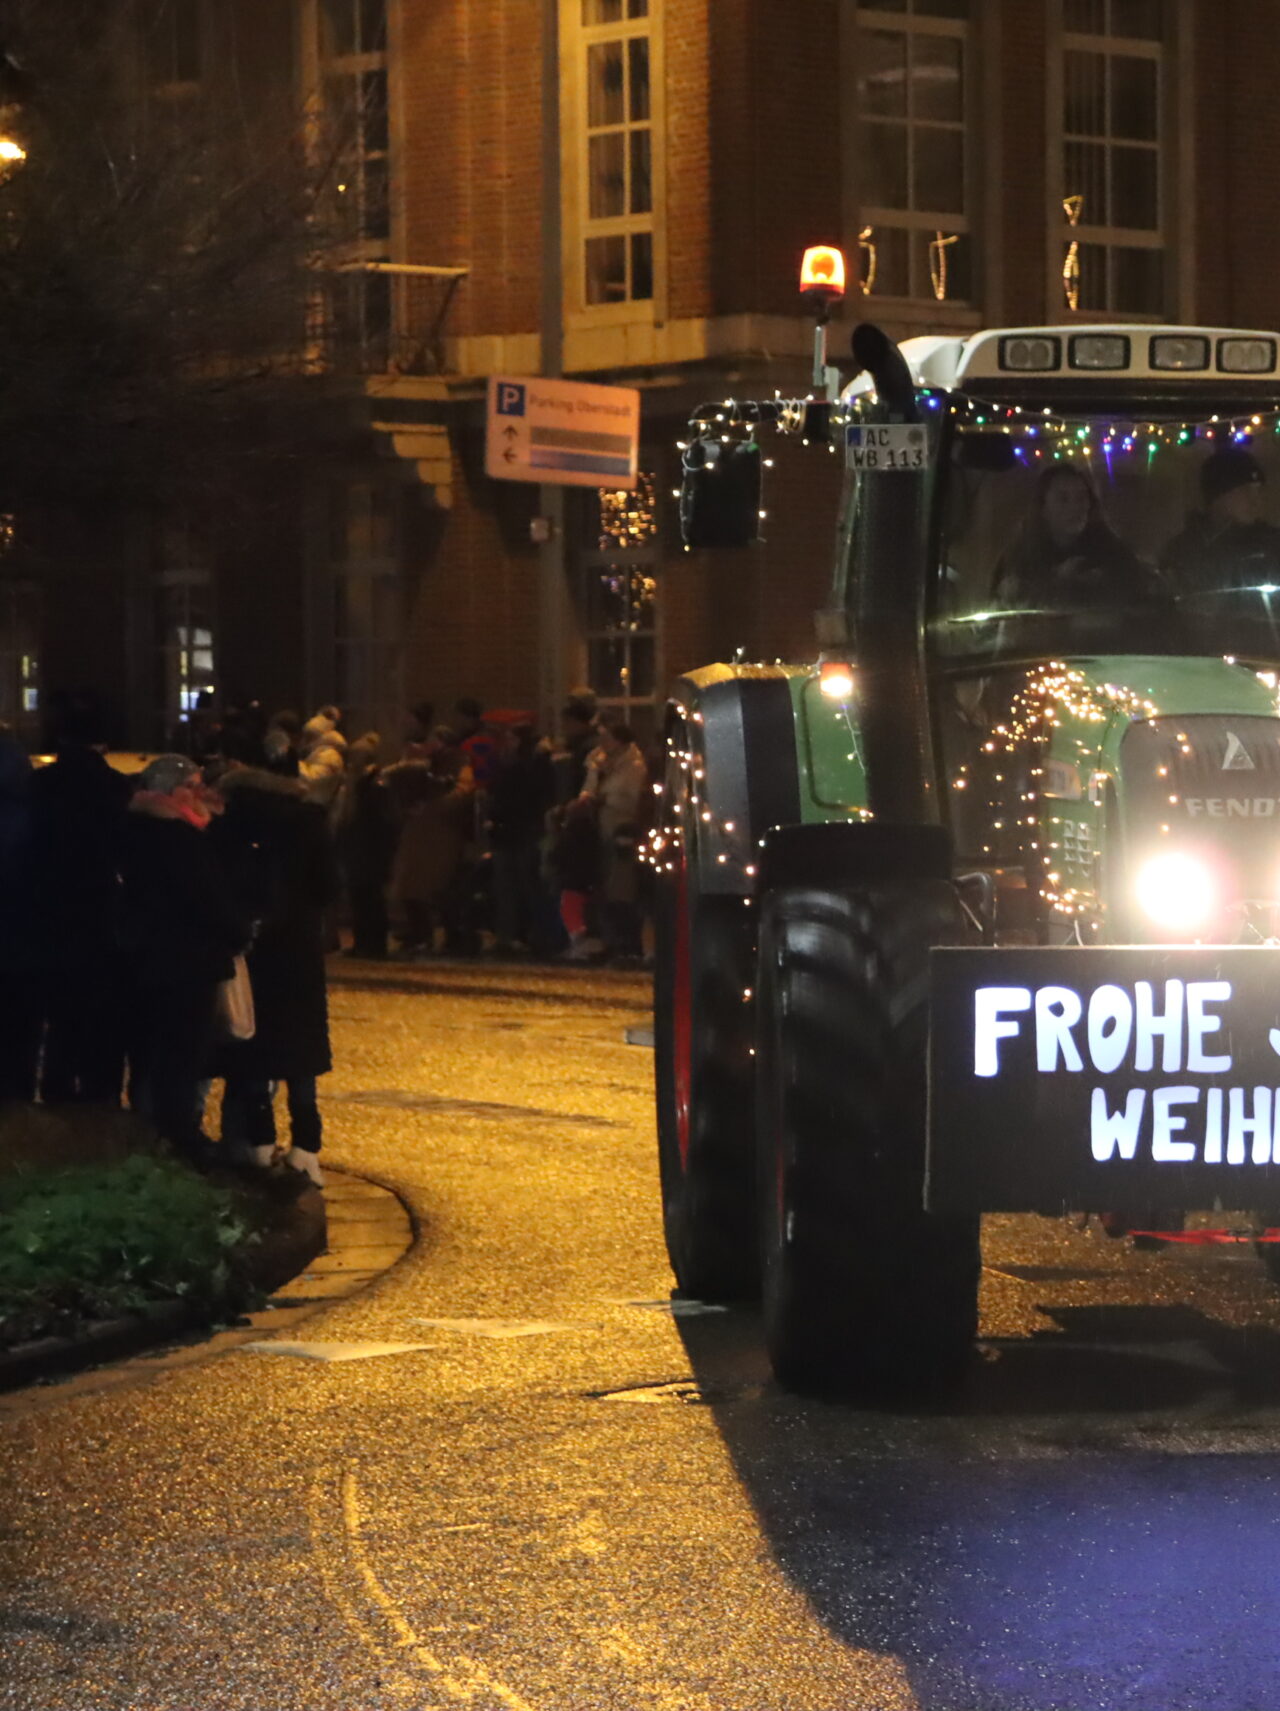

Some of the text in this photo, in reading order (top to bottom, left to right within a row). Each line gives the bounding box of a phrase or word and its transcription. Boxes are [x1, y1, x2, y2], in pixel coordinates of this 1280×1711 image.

[866, 429, 889, 446] AC
[853, 449, 922, 467] WB 113
[975, 979, 1232, 1077] FROHE
